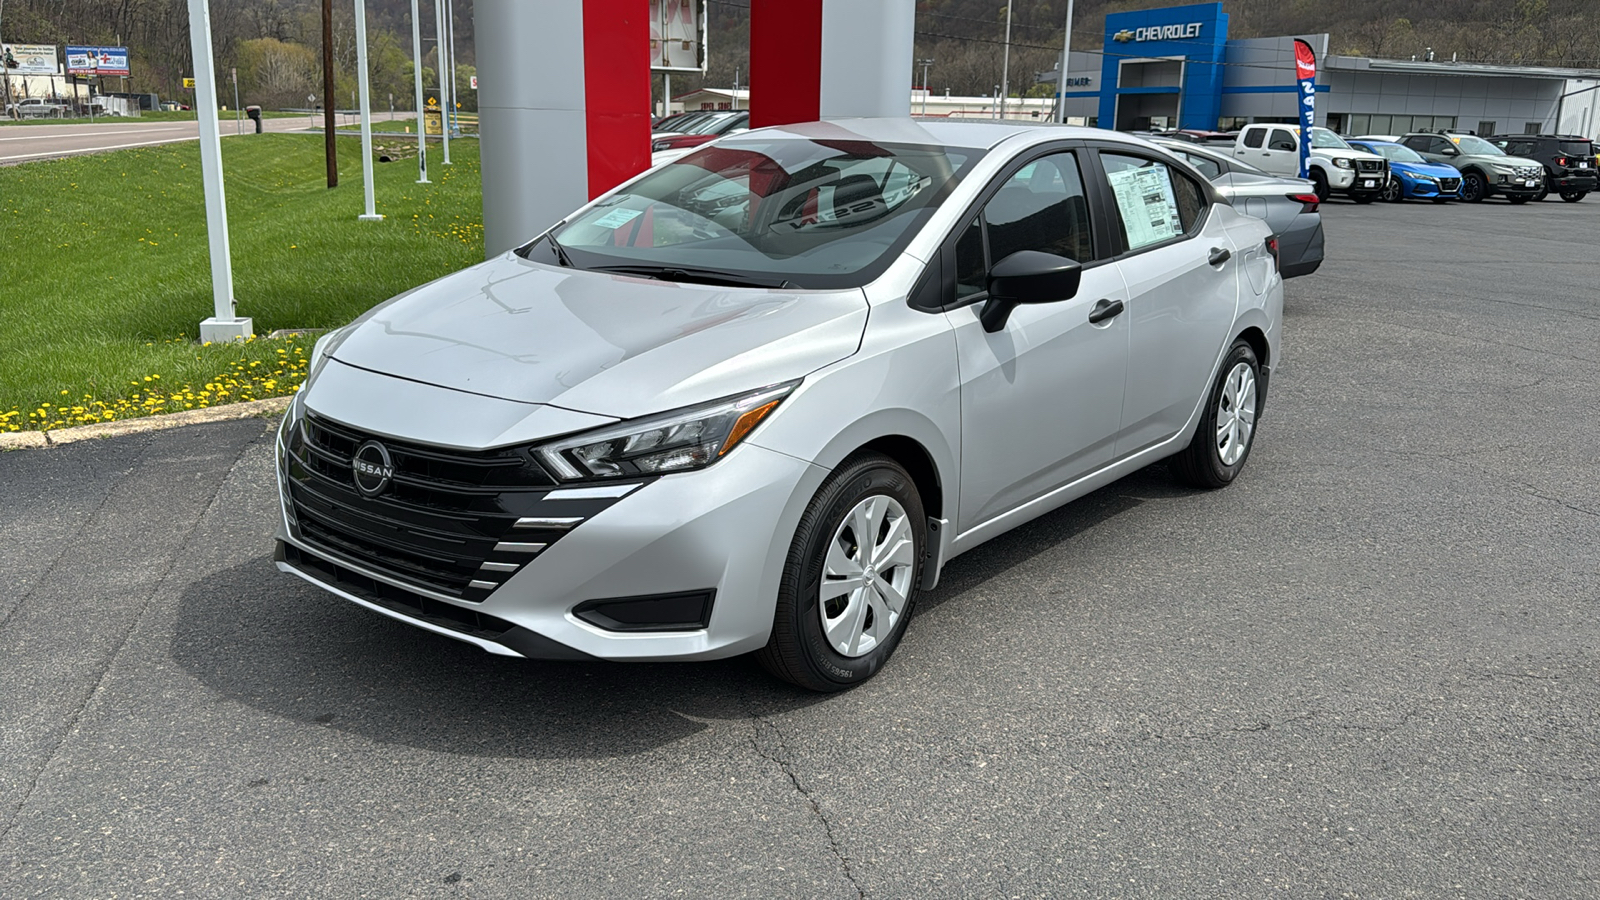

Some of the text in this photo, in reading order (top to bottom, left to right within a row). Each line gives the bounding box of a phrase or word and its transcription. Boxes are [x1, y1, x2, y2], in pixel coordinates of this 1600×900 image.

[1136, 23, 1203, 42] CHEVROLET
[353, 459, 393, 478] NISSAN
[830, 665, 854, 678] 195/65
